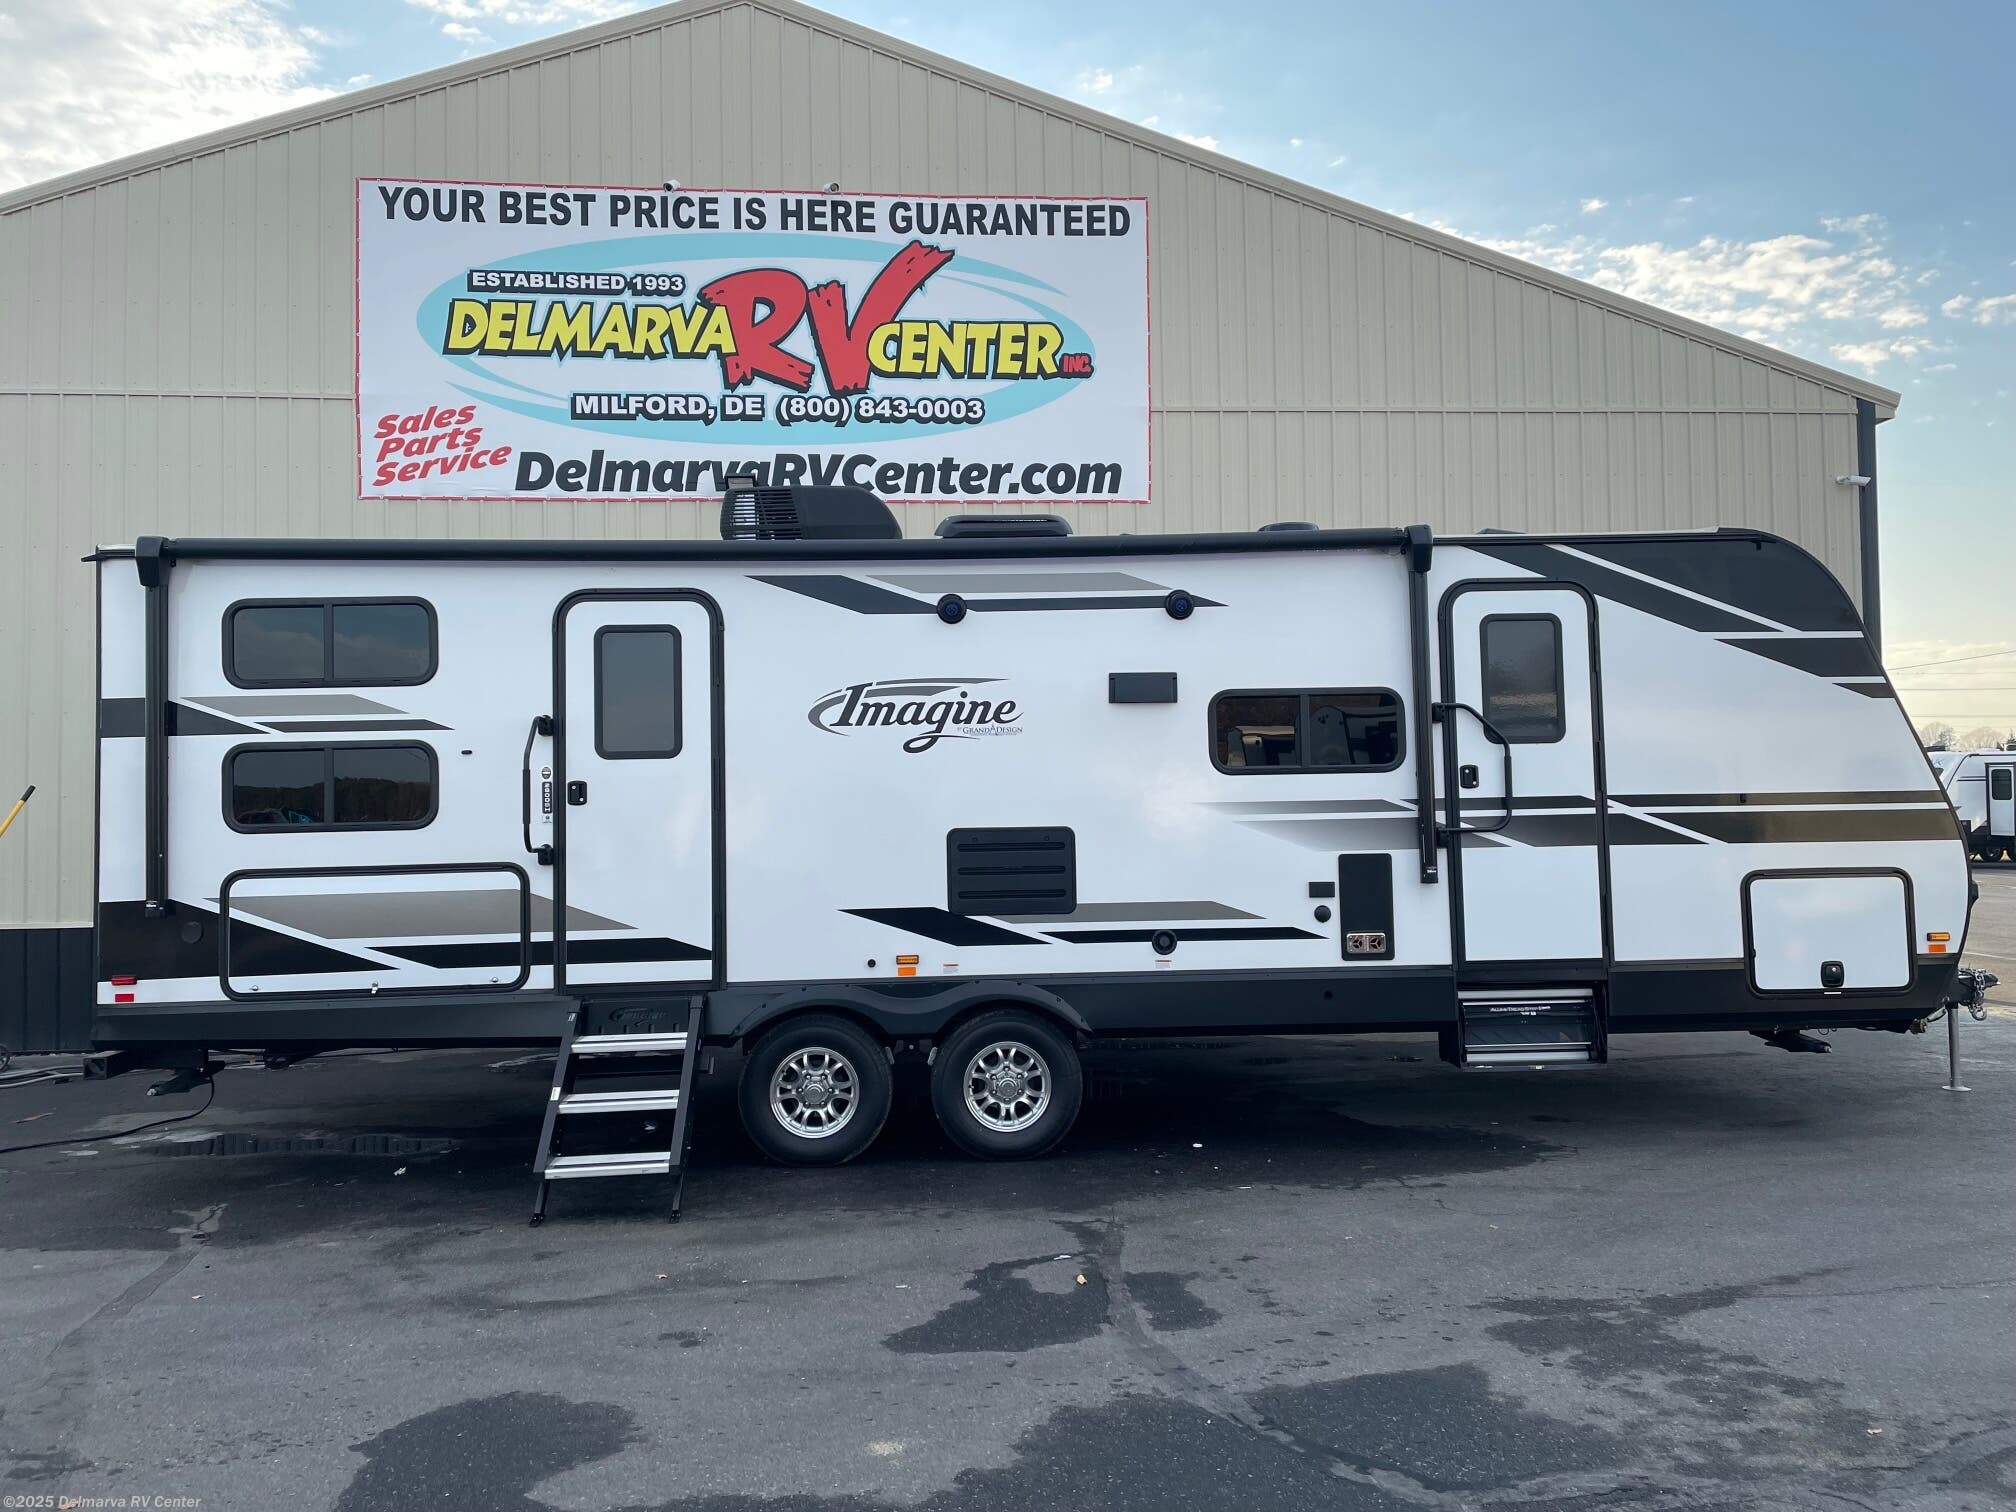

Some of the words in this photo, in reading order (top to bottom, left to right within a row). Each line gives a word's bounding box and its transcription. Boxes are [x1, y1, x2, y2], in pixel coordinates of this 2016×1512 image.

[378, 186, 486, 223] YOUR
[499, 191, 596, 226] BEST
[610, 194, 720, 230] PRICE
[733, 198, 767, 230] IS
[780, 199, 876, 232] HERE
[888, 203, 1130, 236] GUARANTEED
[471, 272, 625, 291] ESTABLISHED
[632, 275, 685, 292] 1993
[446, 300, 738, 357] DELMARVA
[702, 241, 953, 393] RV
[867, 322, 1062, 376] CENTER
[1062, 354, 1093, 374] INC.
[374, 405, 477, 438] Sales
[575, 395, 714, 419] MILFORD,
[724, 396, 763, 416] DE
[780, 396, 850, 424] (800)
[858, 397, 985, 421] 843-0003
[376, 427, 483, 462] Parts
[372, 446, 512, 486] Service
[515, 450, 1122, 494] DelmarvaRVCenter.com
[829, 681, 1025, 754] Imagine
